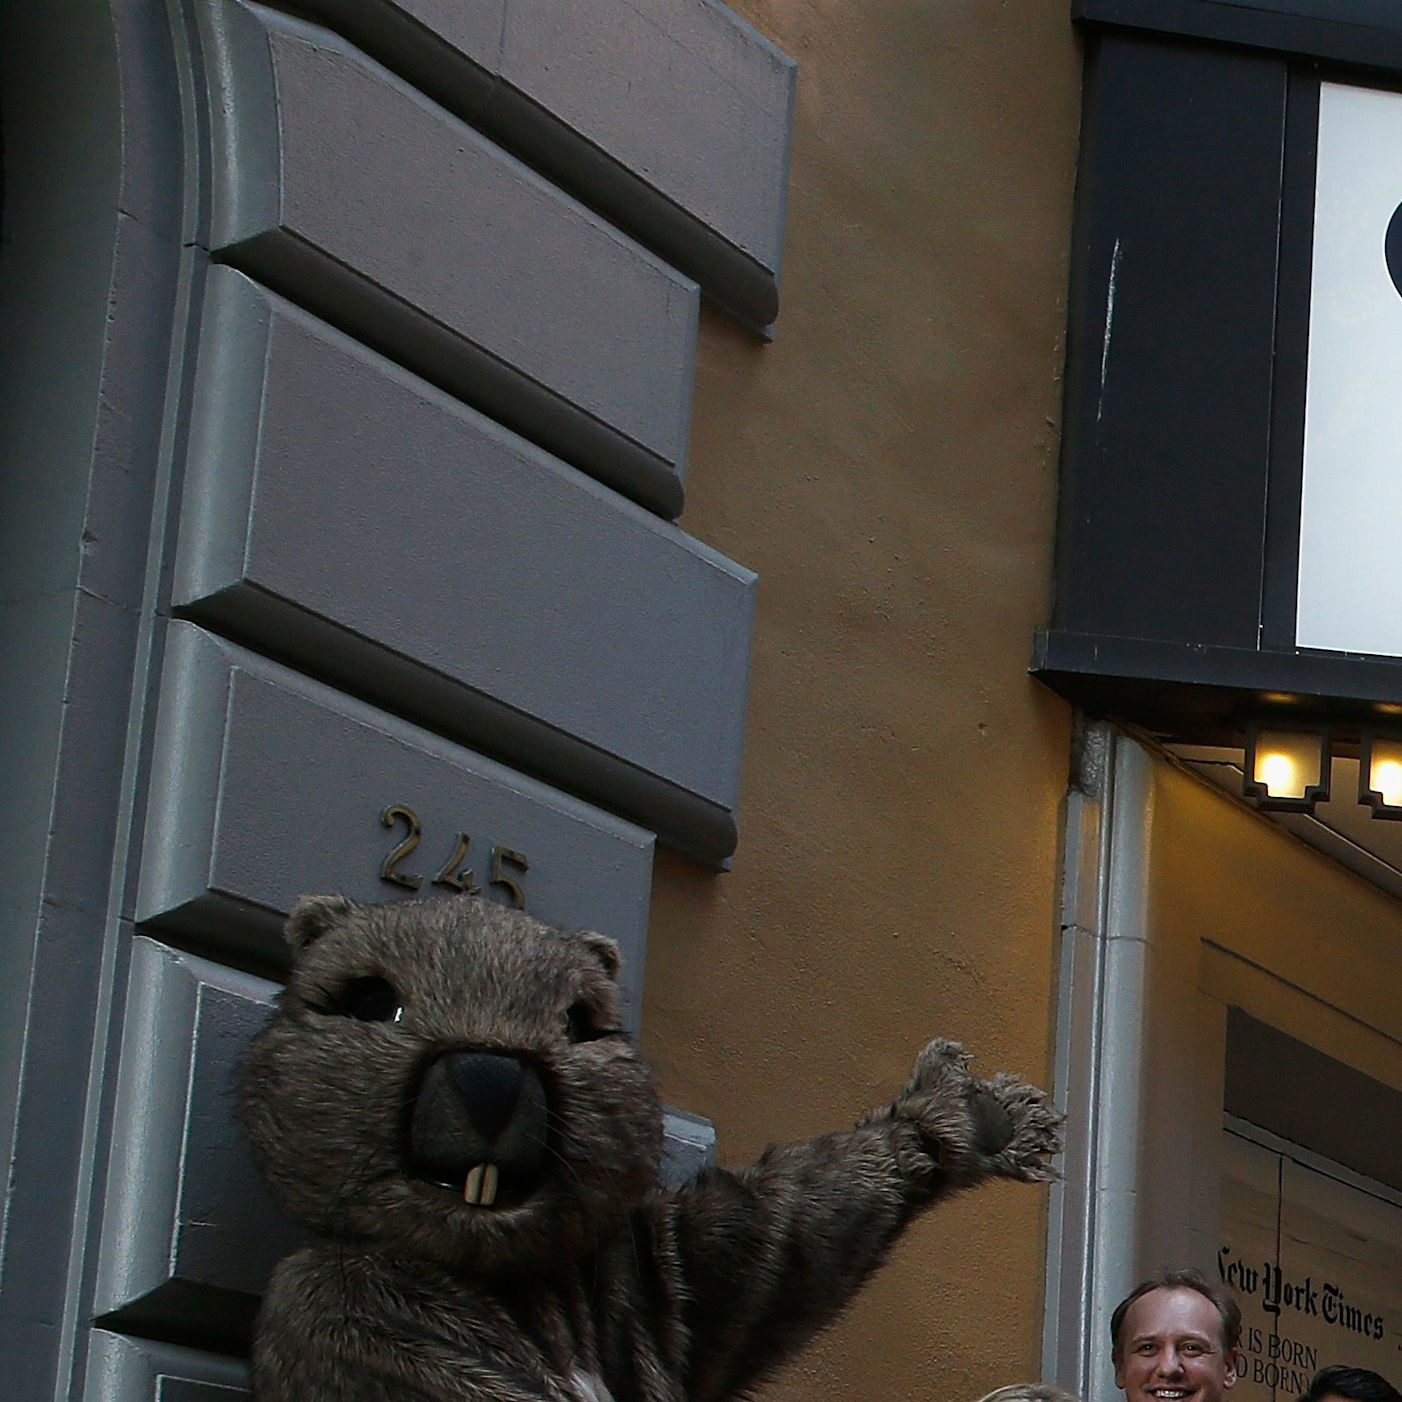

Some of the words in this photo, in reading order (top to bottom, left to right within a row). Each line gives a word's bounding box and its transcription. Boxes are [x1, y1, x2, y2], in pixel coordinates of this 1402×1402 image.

[380, 803, 530, 911] 245
[1262, 1262, 1318, 1318] York
[1321, 1282, 1385, 1341] Times
[1248, 1327, 1263, 1354] IS
[1268, 1334, 1318, 1371] BORN
